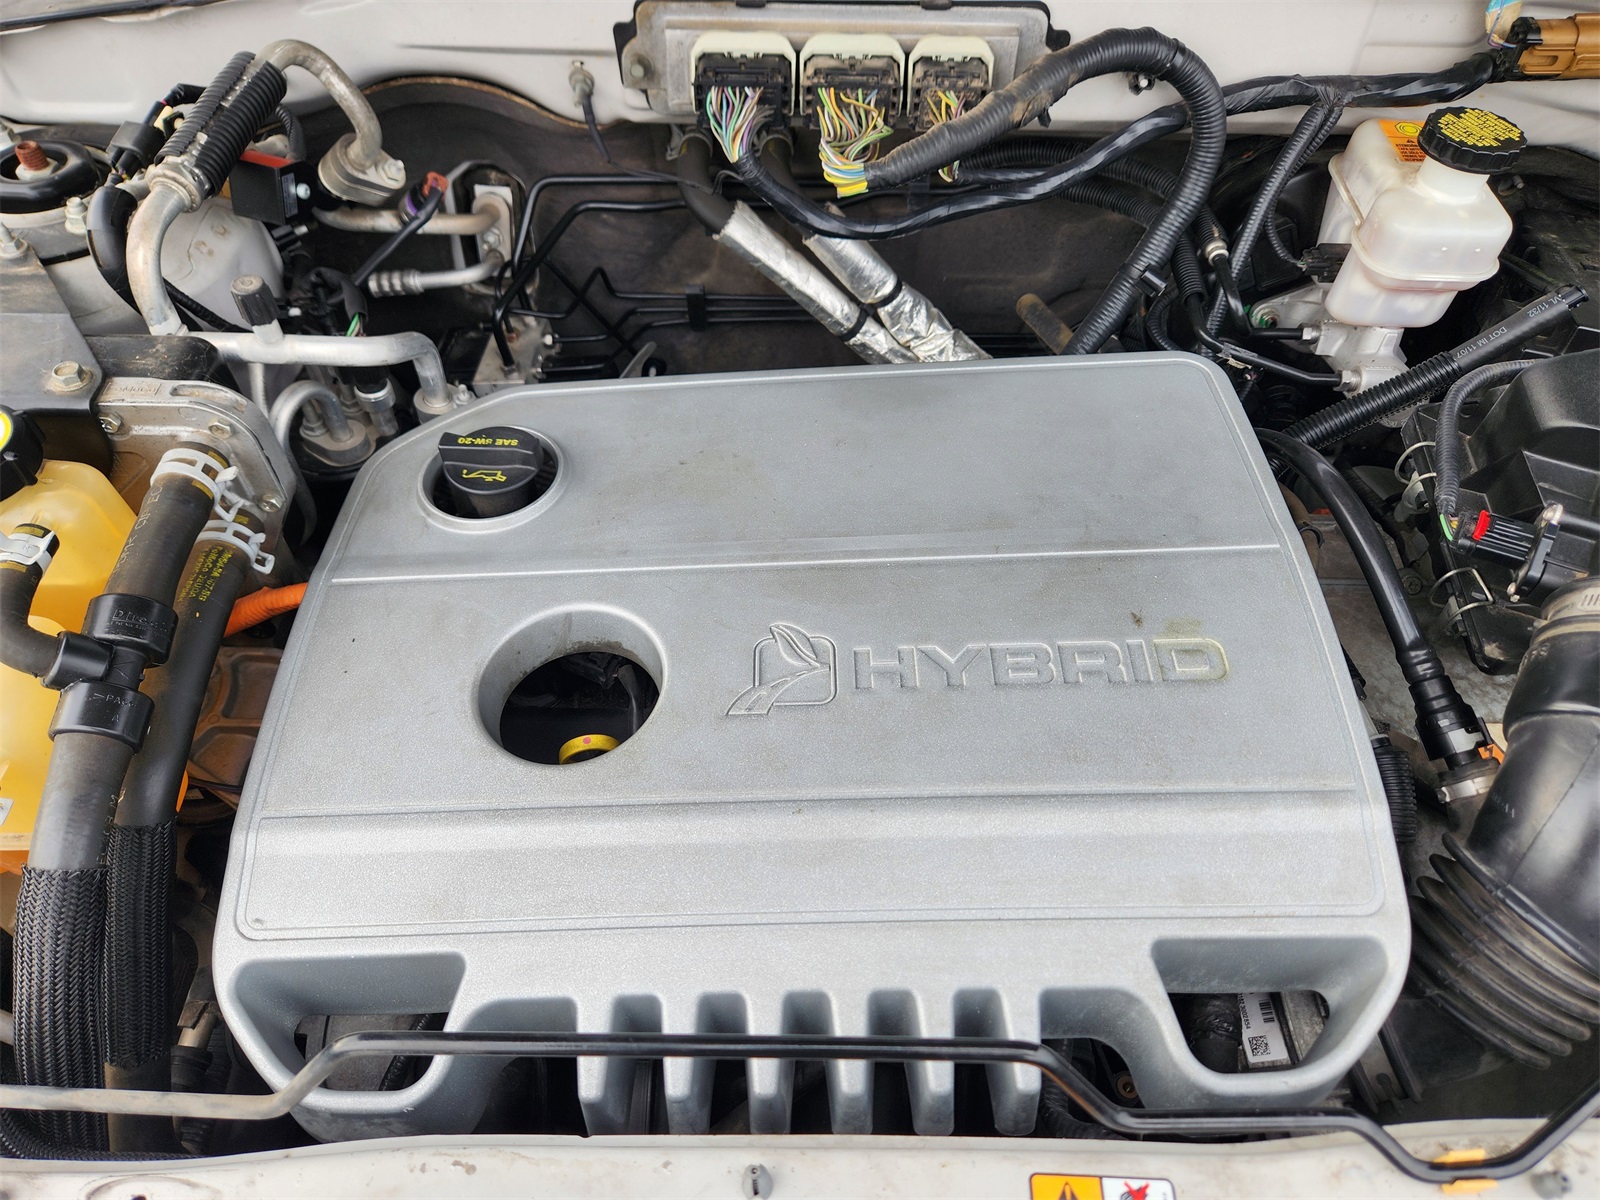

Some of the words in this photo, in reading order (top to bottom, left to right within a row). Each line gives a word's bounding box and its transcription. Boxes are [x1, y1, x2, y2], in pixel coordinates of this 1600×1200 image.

[1527, 301, 1549, 318] 11/32
[1489, 326, 1508, 339] DOT
[457, 437, 493, 445] 5W-20
[495, 438, 519, 446] SAE
[853, 638, 1230, 690] HYBRID
